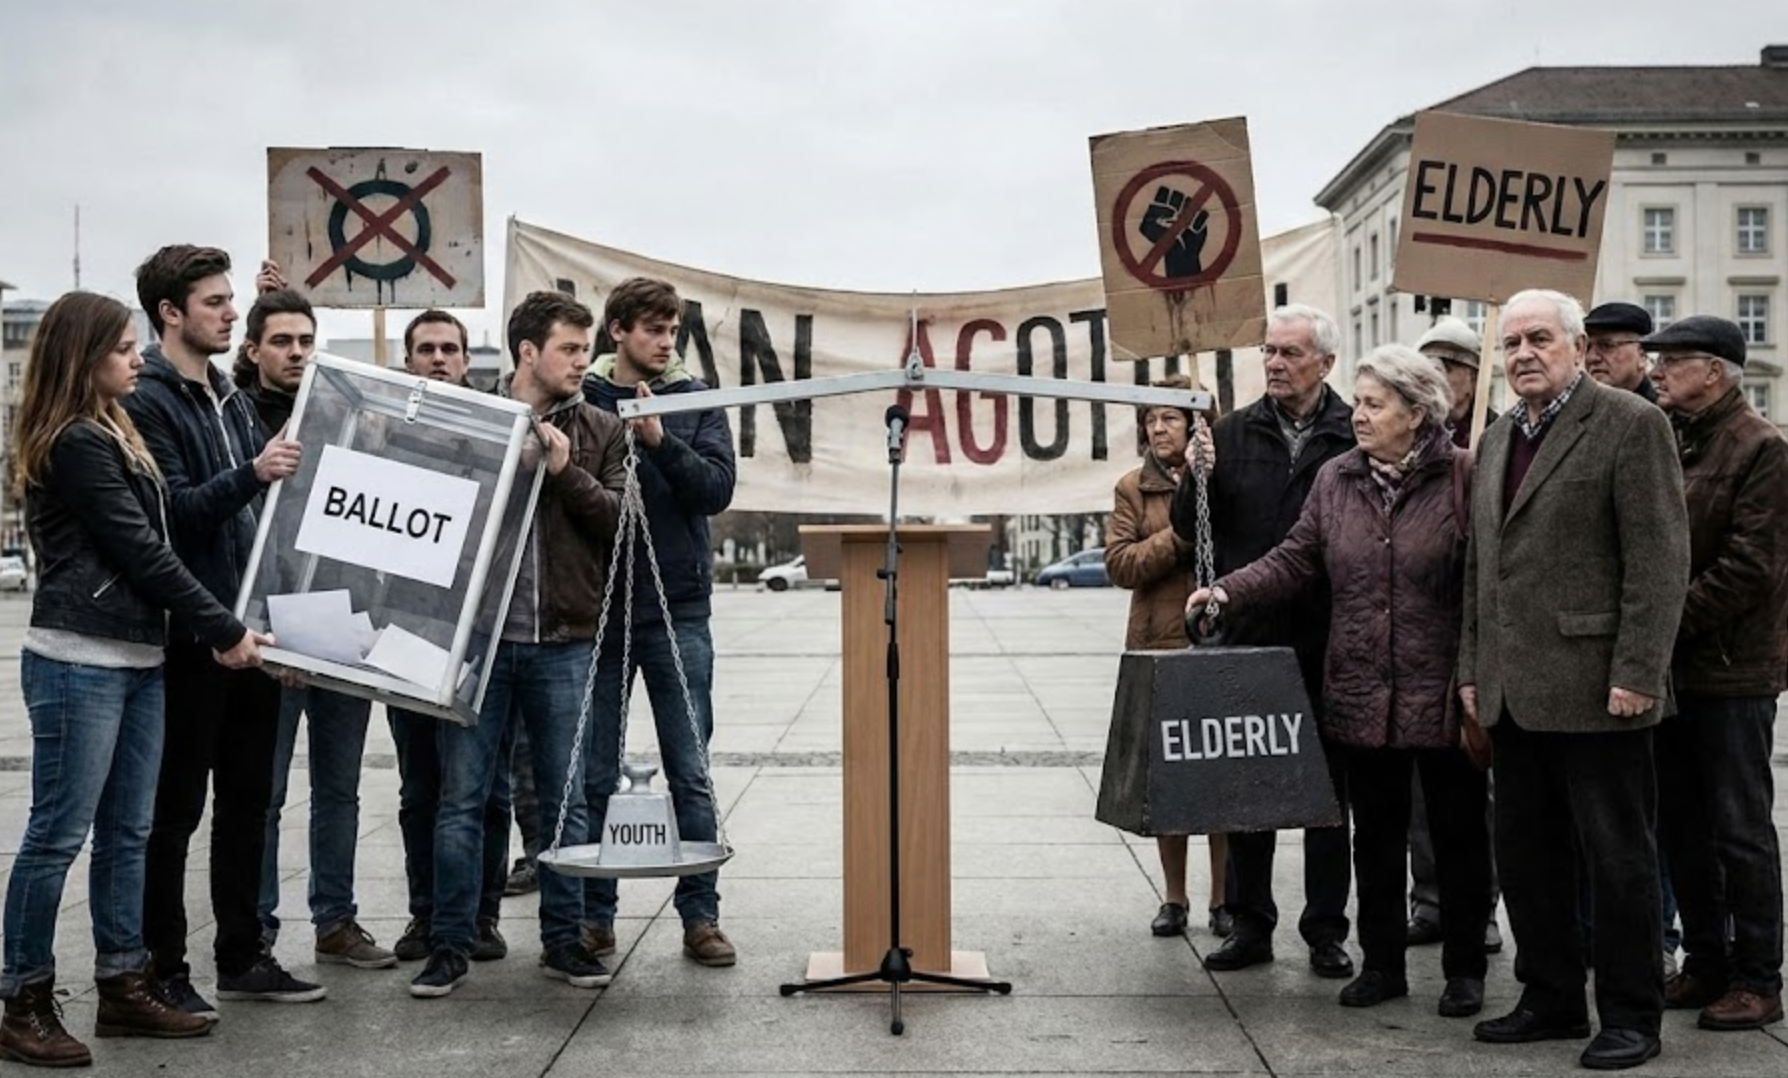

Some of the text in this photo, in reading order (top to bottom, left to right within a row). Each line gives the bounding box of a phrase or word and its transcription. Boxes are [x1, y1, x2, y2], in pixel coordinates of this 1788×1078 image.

[1412, 160, 1607, 238] ELDERLY
[323, 485, 453, 544] BALLOT
[1160, 712, 1302, 762] ELDERLY
[608, 823, 667, 845] YOUTH
